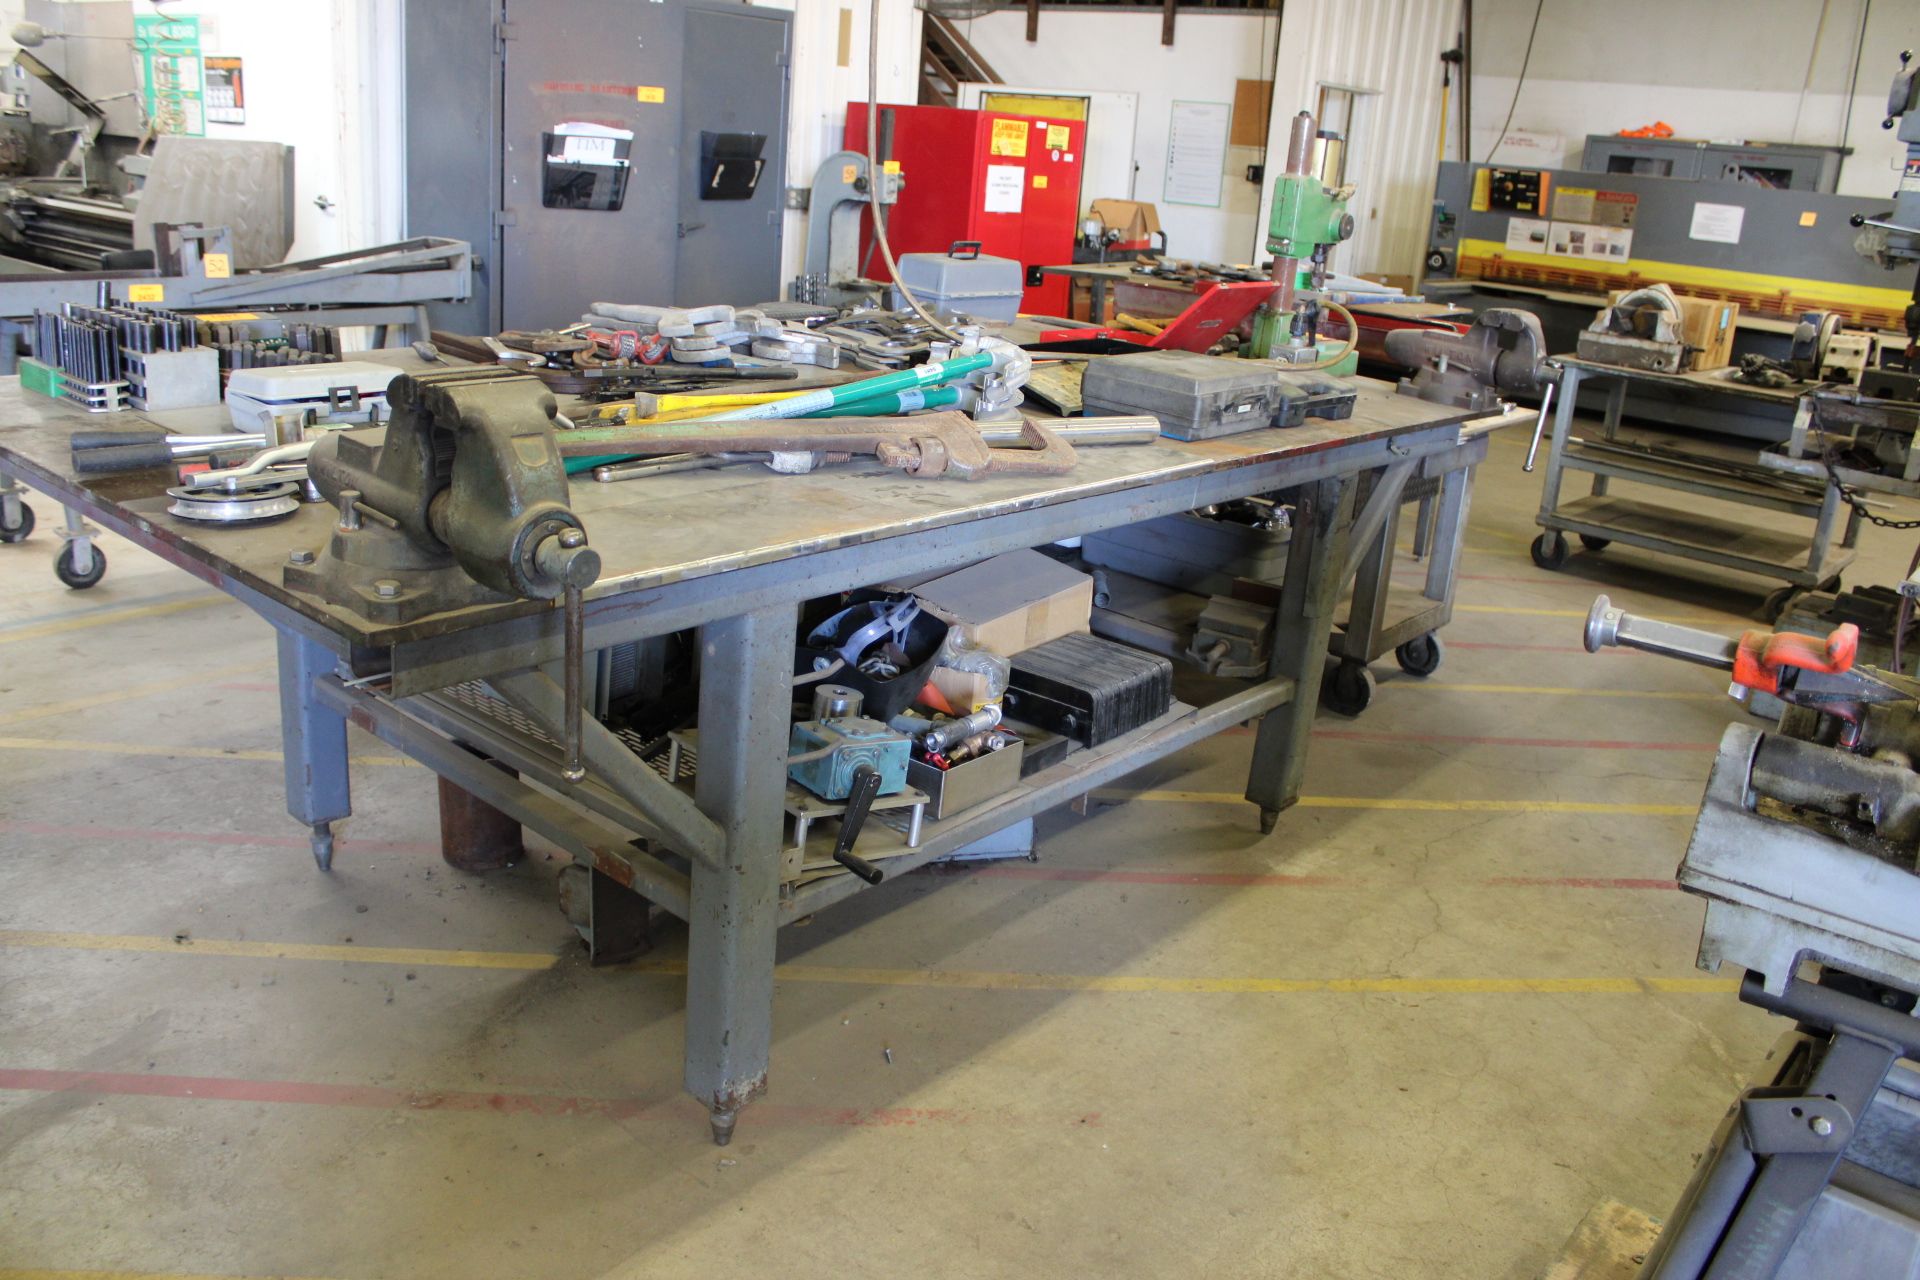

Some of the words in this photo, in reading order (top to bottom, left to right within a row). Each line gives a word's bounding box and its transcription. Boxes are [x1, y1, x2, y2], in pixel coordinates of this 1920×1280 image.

[995, 121, 1027, 132] FLAMMABLE
[576, 138, 605, 152] TIM
[208, 259, 227, 272] 52
